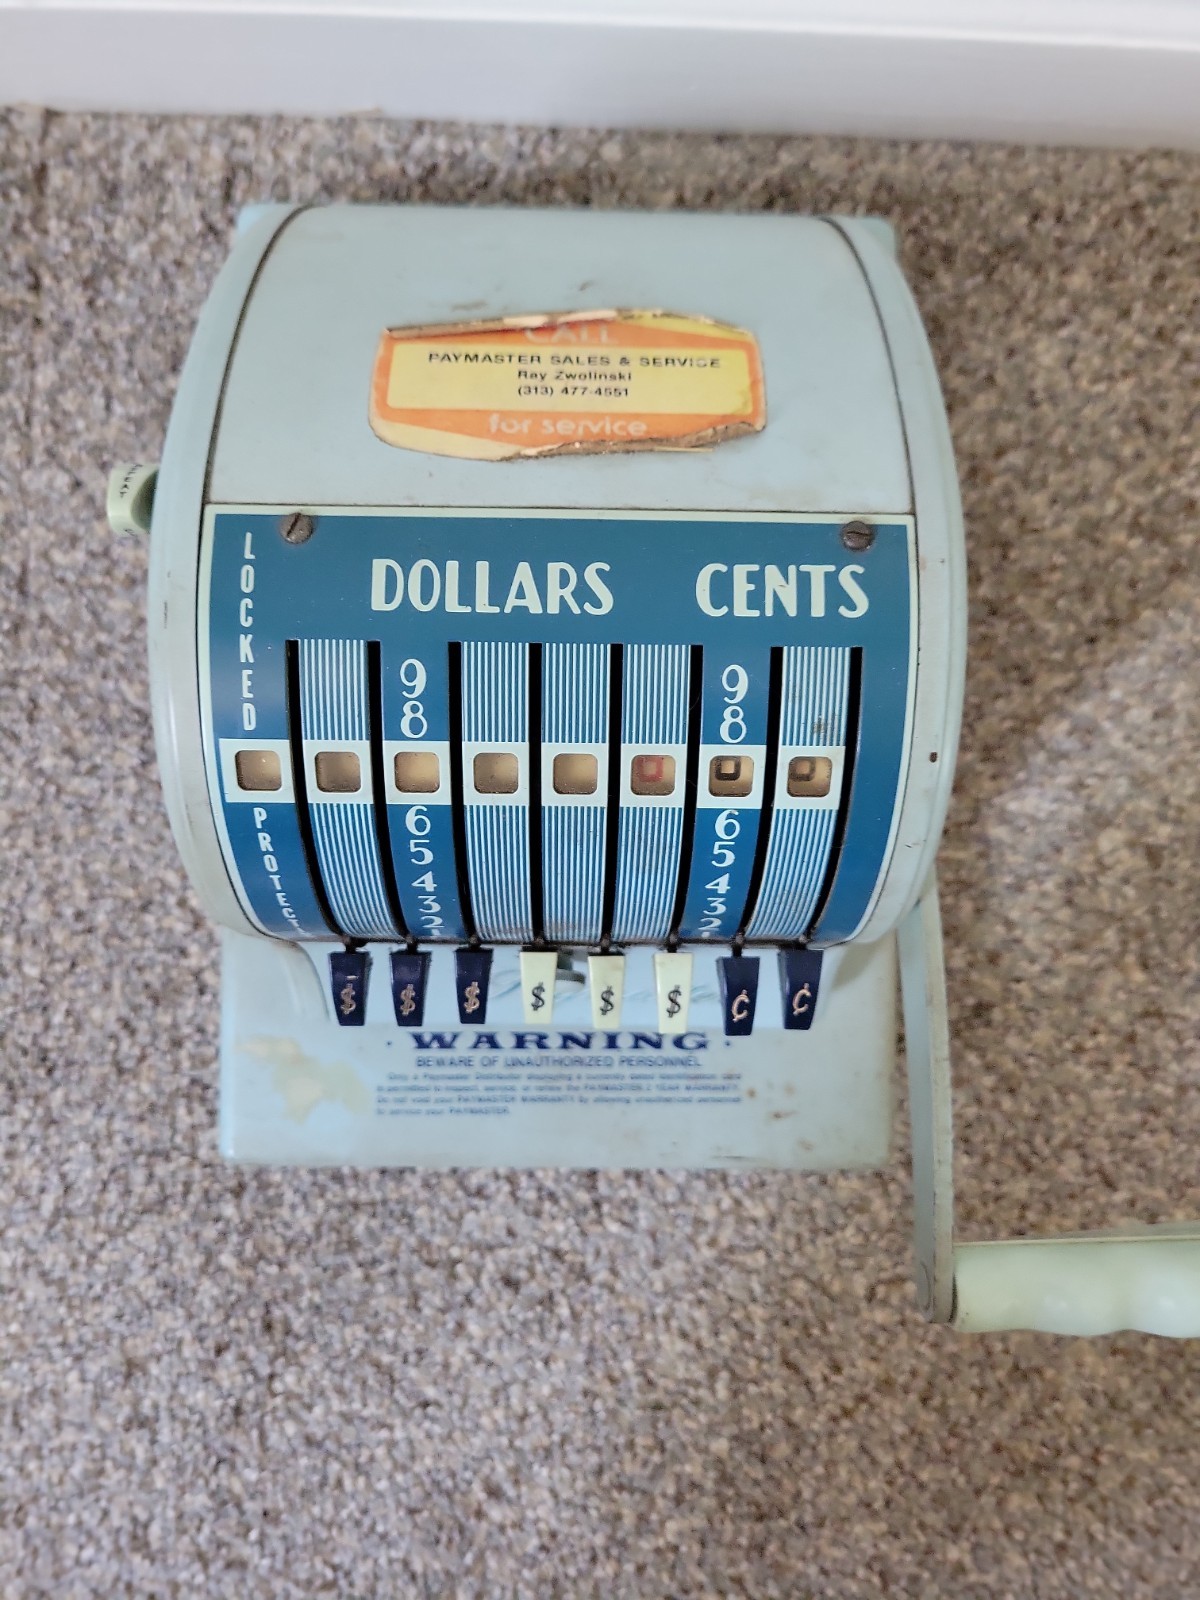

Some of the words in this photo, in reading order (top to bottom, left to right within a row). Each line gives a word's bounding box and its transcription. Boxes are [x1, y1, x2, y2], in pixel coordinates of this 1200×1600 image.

[428, 353, 541, 364] PAYMASTER
[550, 355, 610, 367] SALES
[619, 356, 630, 367] &
[639, 357, 720, 368] SERVICE
[517, 385, 554, 397] (313)
[561, 386, 628, 397] 477-4551
[518, 370, 548, 382] Ray
[555, 370, 631, 381] Zwolinski
[489, 413, 532, 434] for
[541, 415, 648, 436] service
[370, 558, 615, 616] DOLLARS
[695, 563, 870, 619] CENTS
[239, 531, 257, 732] LOCKED
[399, 659, 427, 699] 9
[721, 664, 749, 704] 9
[400, 701, 428, 739] 8
[719, 706, 747, 743] 8
[405, 805, 432, 837] 6
[714, 810, 741, 840] 6
[410, 839, 434, 866] 5
[711, 842, 736, 868] 5
[411, 871, 438, 892] 4
[704, 873, 731, 894] 4
[417, 895, 441, 913] 3
[703, 897, 727, 915] 3
[340, 983, 357, 1015] $
[400, 983, 416, 1016] $
[463, 981, 480, 1014] $
[531, 981, 545, 1011] $
[600, 985, 615, 1016] $
[666, 984, 682, 1018] $
[409, 1031, 709, 1050] WARNING
[416, 1056, 474, 1067] BEWARE
[480, 1056, 499, 1067] OF
[505, 1056, 614, 1067] UNAUTHORIZED
[619, 1056, 703, 1067] PERSONNEL
